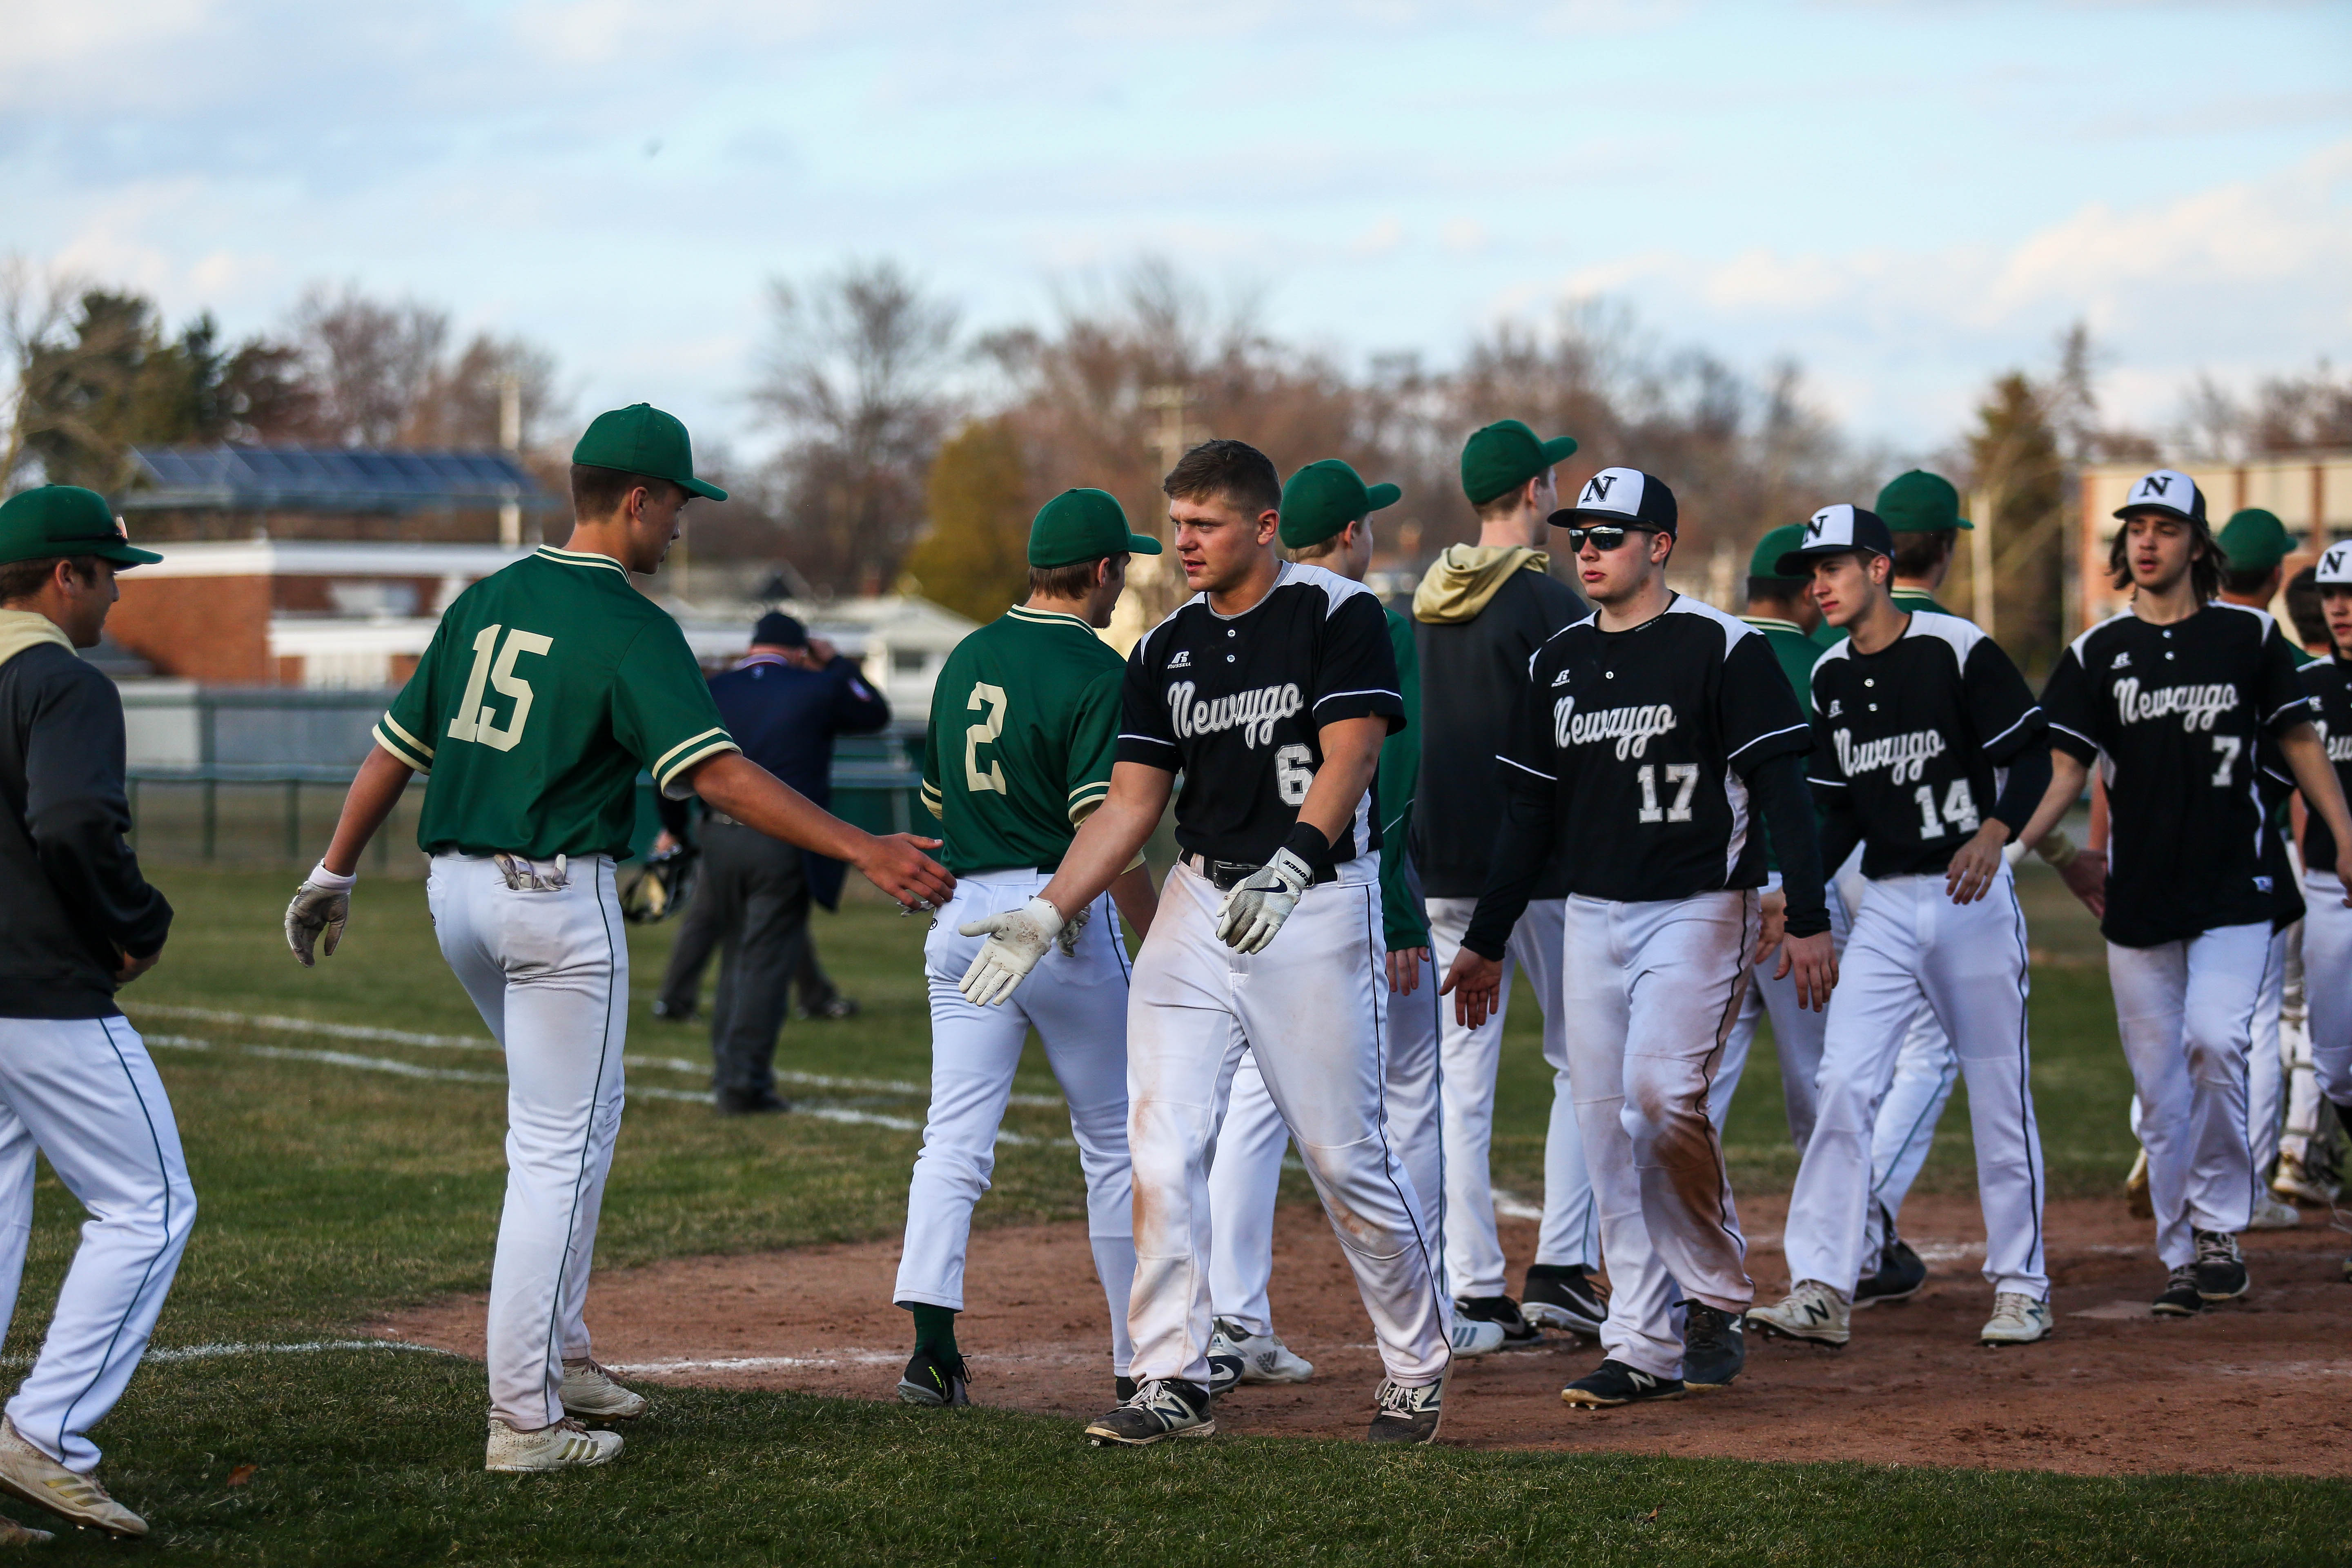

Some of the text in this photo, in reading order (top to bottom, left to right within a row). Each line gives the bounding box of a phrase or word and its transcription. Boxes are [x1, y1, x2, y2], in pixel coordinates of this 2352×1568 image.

[1581, 476, 1618, 503] N
[2139, 476, 2174, 497] N
[1802, 515, 1829, 544] N
[2321, 551, 2347, 574] N
[448, 624, 554, 752] 15
[1167, 680, 1304, 750] Newaygo
[2113, 677, 2240, 733] Newaygo
[965, 681, 1008, 795] 2
[1554, 695, 1677, 762] Newaygo
[1274, 743, 1316, 807] 6
[2212, 735, 2242, 787] 7
[1637, 763, 1700, 824] 17
[1914, 777, 1981, 840] 14
[1153, 1396, 1190, 1430] N
